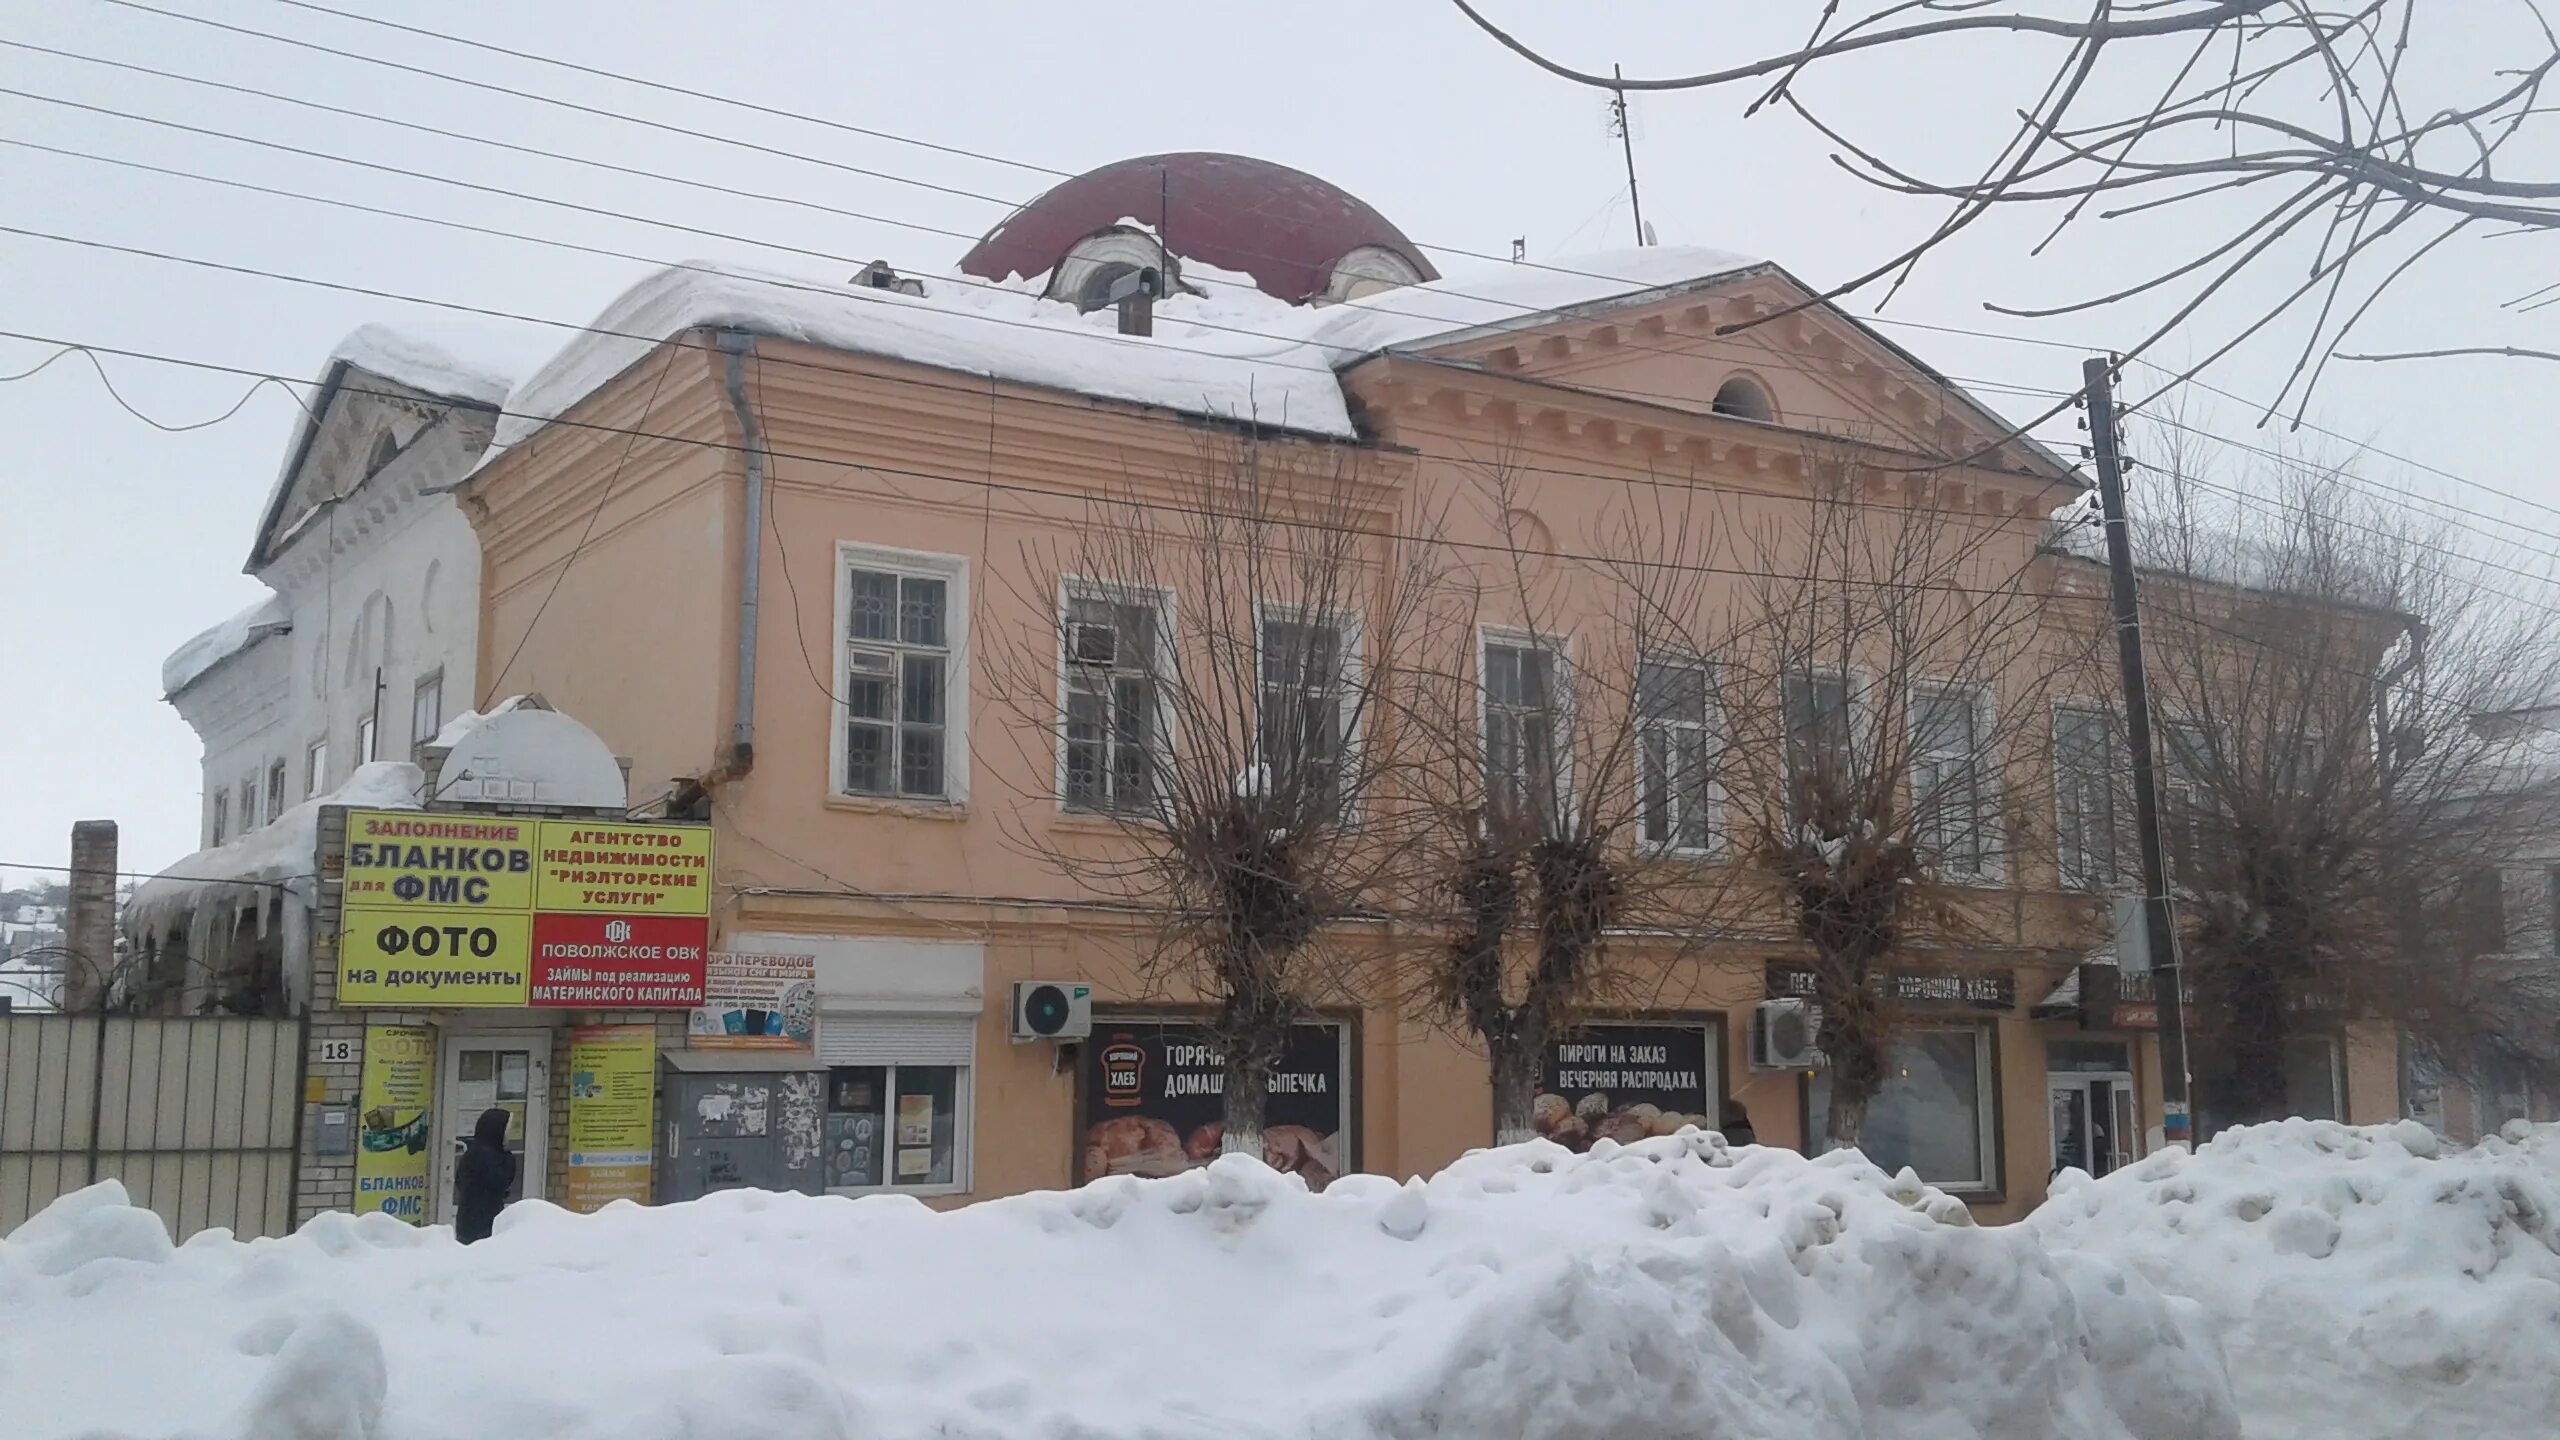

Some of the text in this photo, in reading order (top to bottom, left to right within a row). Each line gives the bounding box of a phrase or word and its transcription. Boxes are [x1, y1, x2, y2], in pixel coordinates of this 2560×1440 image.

[366, 819, 519, 841] ЗАПОЛНЕНИЕ
[570, 831, 682, 848] АГЕНТСТВО
[350, 844, 530, 872] БЛАНКОВ
[543, 849, 706, 868] НЕДВИЖИМОСТИ
[550, 869, 697, 887] "РИЭЛТОРСКИЕ
[351, 875, 490, 904] для ФМС
[582, 890, 665, 905] УСЛУГИ"
[376, 925, 497, 958] ФОТО
[542, 944, 699, 960] ПОВОЛЖСКОЕ ОВК
[735, 955, 814, 968] ПЕРЕВОДОВ
[347, 969, 521, 989] на документы
[547, 966, 691, 984] ЗАЙМЫ под реализацию
[533, 986, 634, 1000] МАТЕРИНСКОГО
[638, 987, 702, 1001] КАПИТАЛА
[325, 1043, 349, 1060] 18
[1559, 1044, 1667, 1063] ПИРОГИ НА ЗАКАЗ
[1111, 1071, 1136, 1086] ХЛЕБ
[1264, 1073, 1327, 1093] ЫПЕЧКА
[1559, 1070, 1697, 1092] ВЕЧЕРНЯЯ РАСПРОДАЖА
[360, 1175, 425, 1191] БЛАНКОВ
[382, 1195, 422, 1216] ФМС
